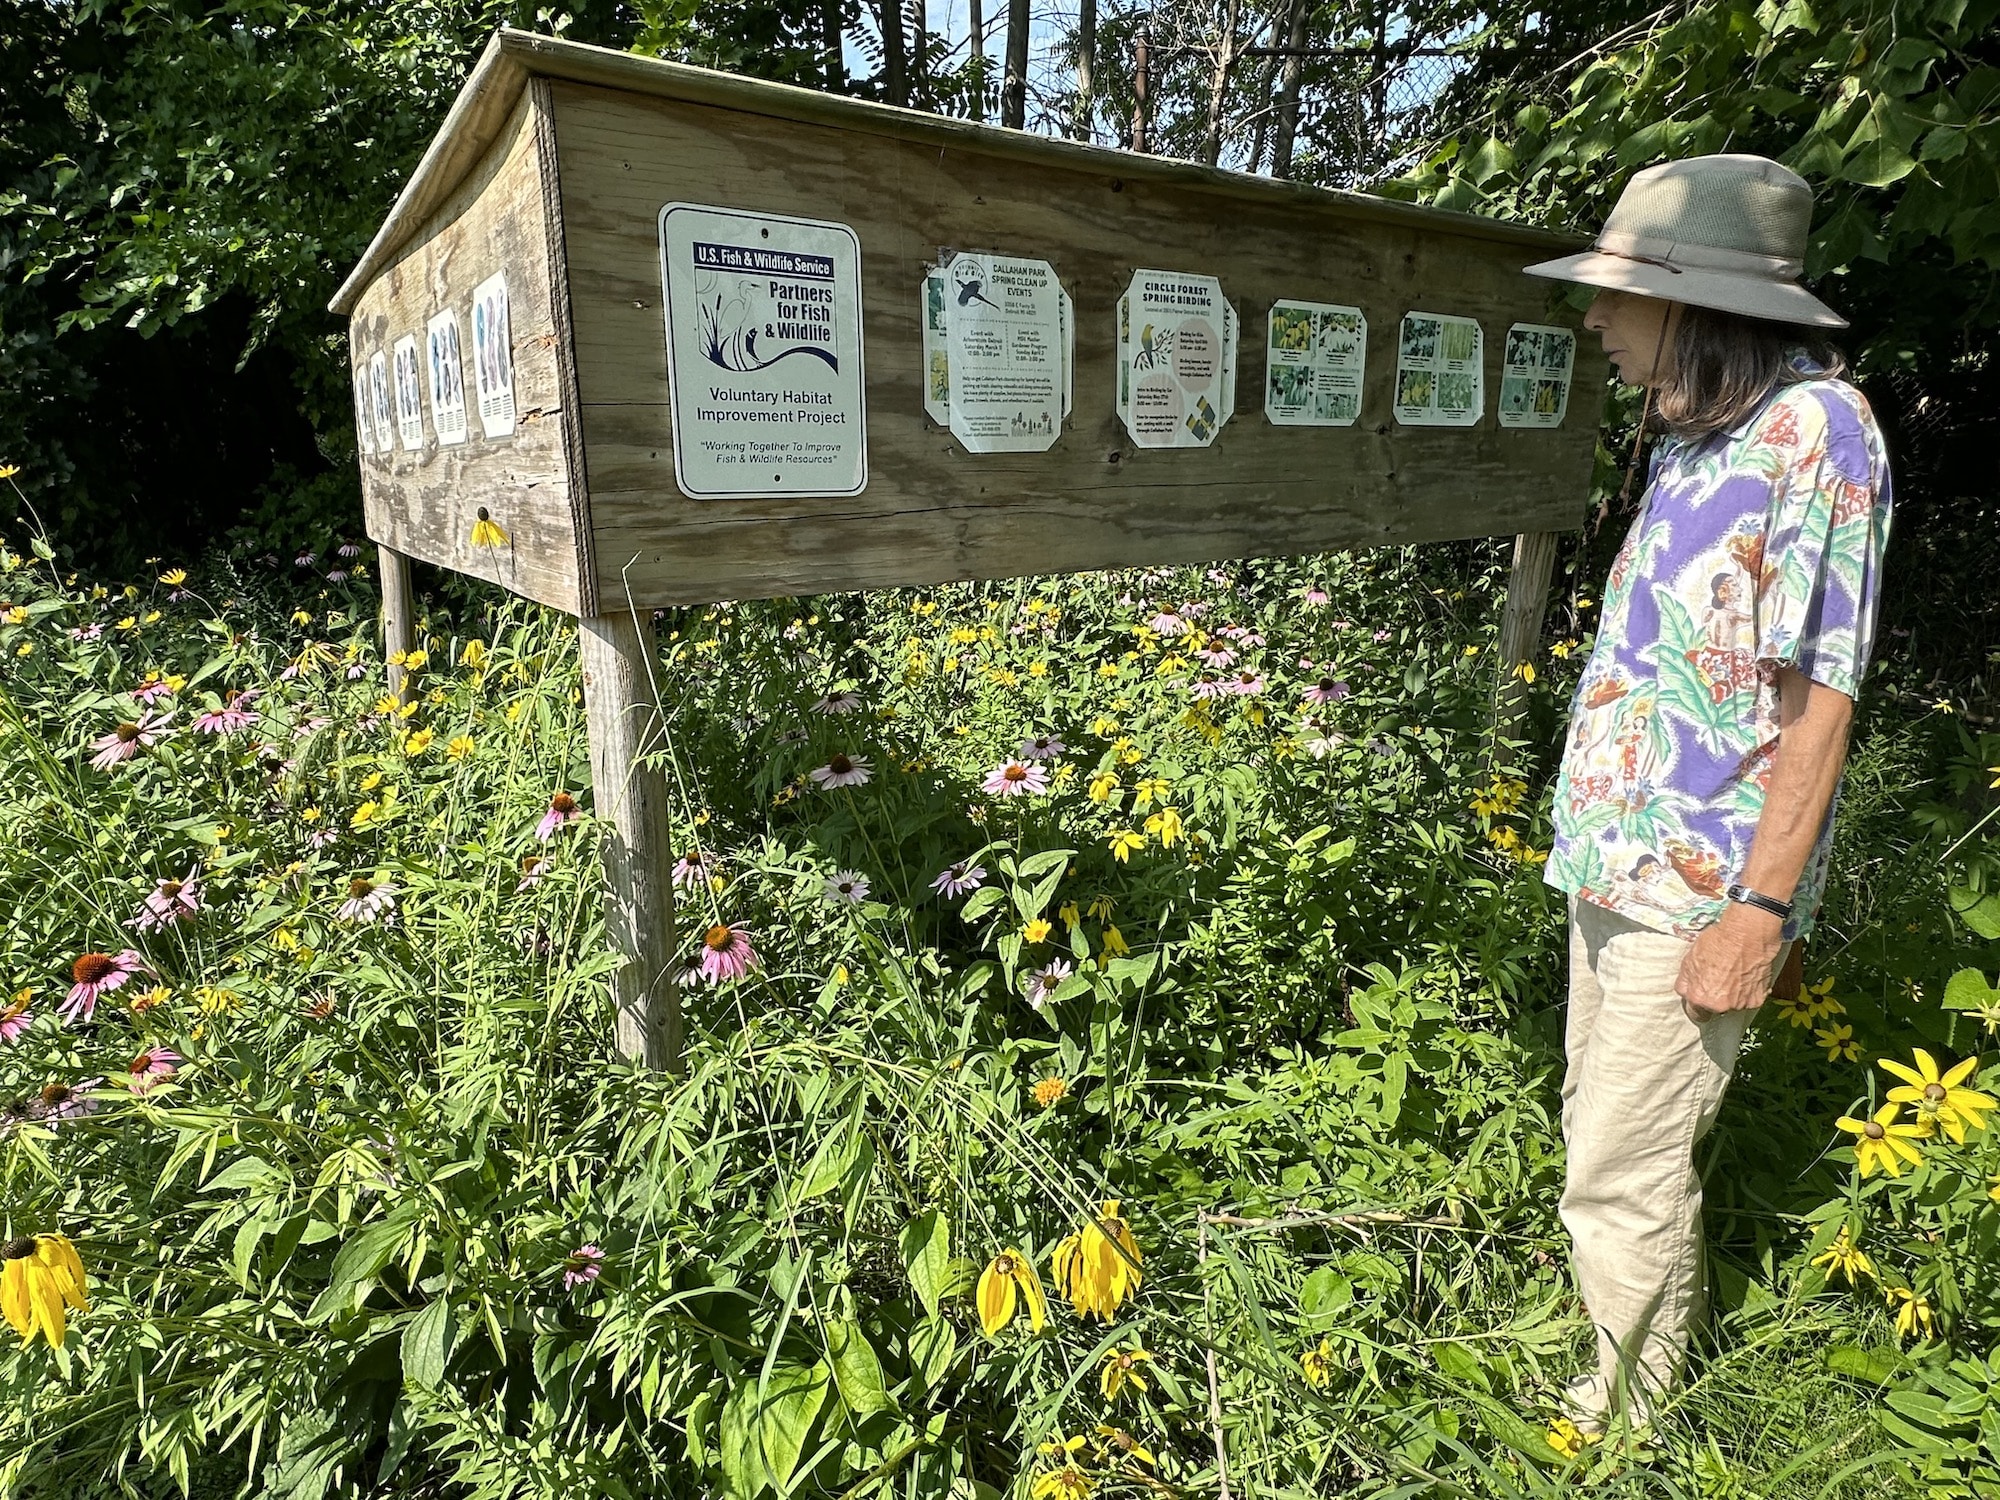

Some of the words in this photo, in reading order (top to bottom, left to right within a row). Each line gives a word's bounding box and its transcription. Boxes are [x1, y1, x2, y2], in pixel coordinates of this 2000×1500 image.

[698, 246, 720, 263] U.S.
[721, 249, 742, 266] Fish
[744, 252, 753, 267] &
[754, 252, 793, 271] Wildlife
[795, 258, 830, 275] Service
[993, 264, 1028, 276] CALLAHAN
[1029, 268, 1046, 277] PARK
[992, 275, 1016, 285] SPRING
[1017, 278, 1038, 287] CLEAN
[1039, 280, 1048, 288] UP
[770, 281, 832, 303] Partners
[1008, 288, 1032, 297] EVENTS
[1145, 282, 1175, 293] CIRCLE
[1178, 285, 1208, 296] FOREST
[1143, 293, 1176, 304] SPRING
[1177, 296, 1212, 307] BIRDING
[777, 302, 798, 319] for
[801, 304, 830, 322] Fish
[765, 323, 775, 338] &
[778, 322, 830, 342] Wildlife
[710, 387, 778, 406] Voluntary
[783, 390, 833, 405] Habitat
[697, 407, 794, 424] Improvement
[798, 410, 846, 426] Project
[749, 442, 790, 453] Together
[793, 442, 802, 451] To
[805, 442, 841, 453] Improve
[716, 454, 736, 463] Fish
[739, 454, 746, 463] &
[749, 454, 783, 464] Wildlife
